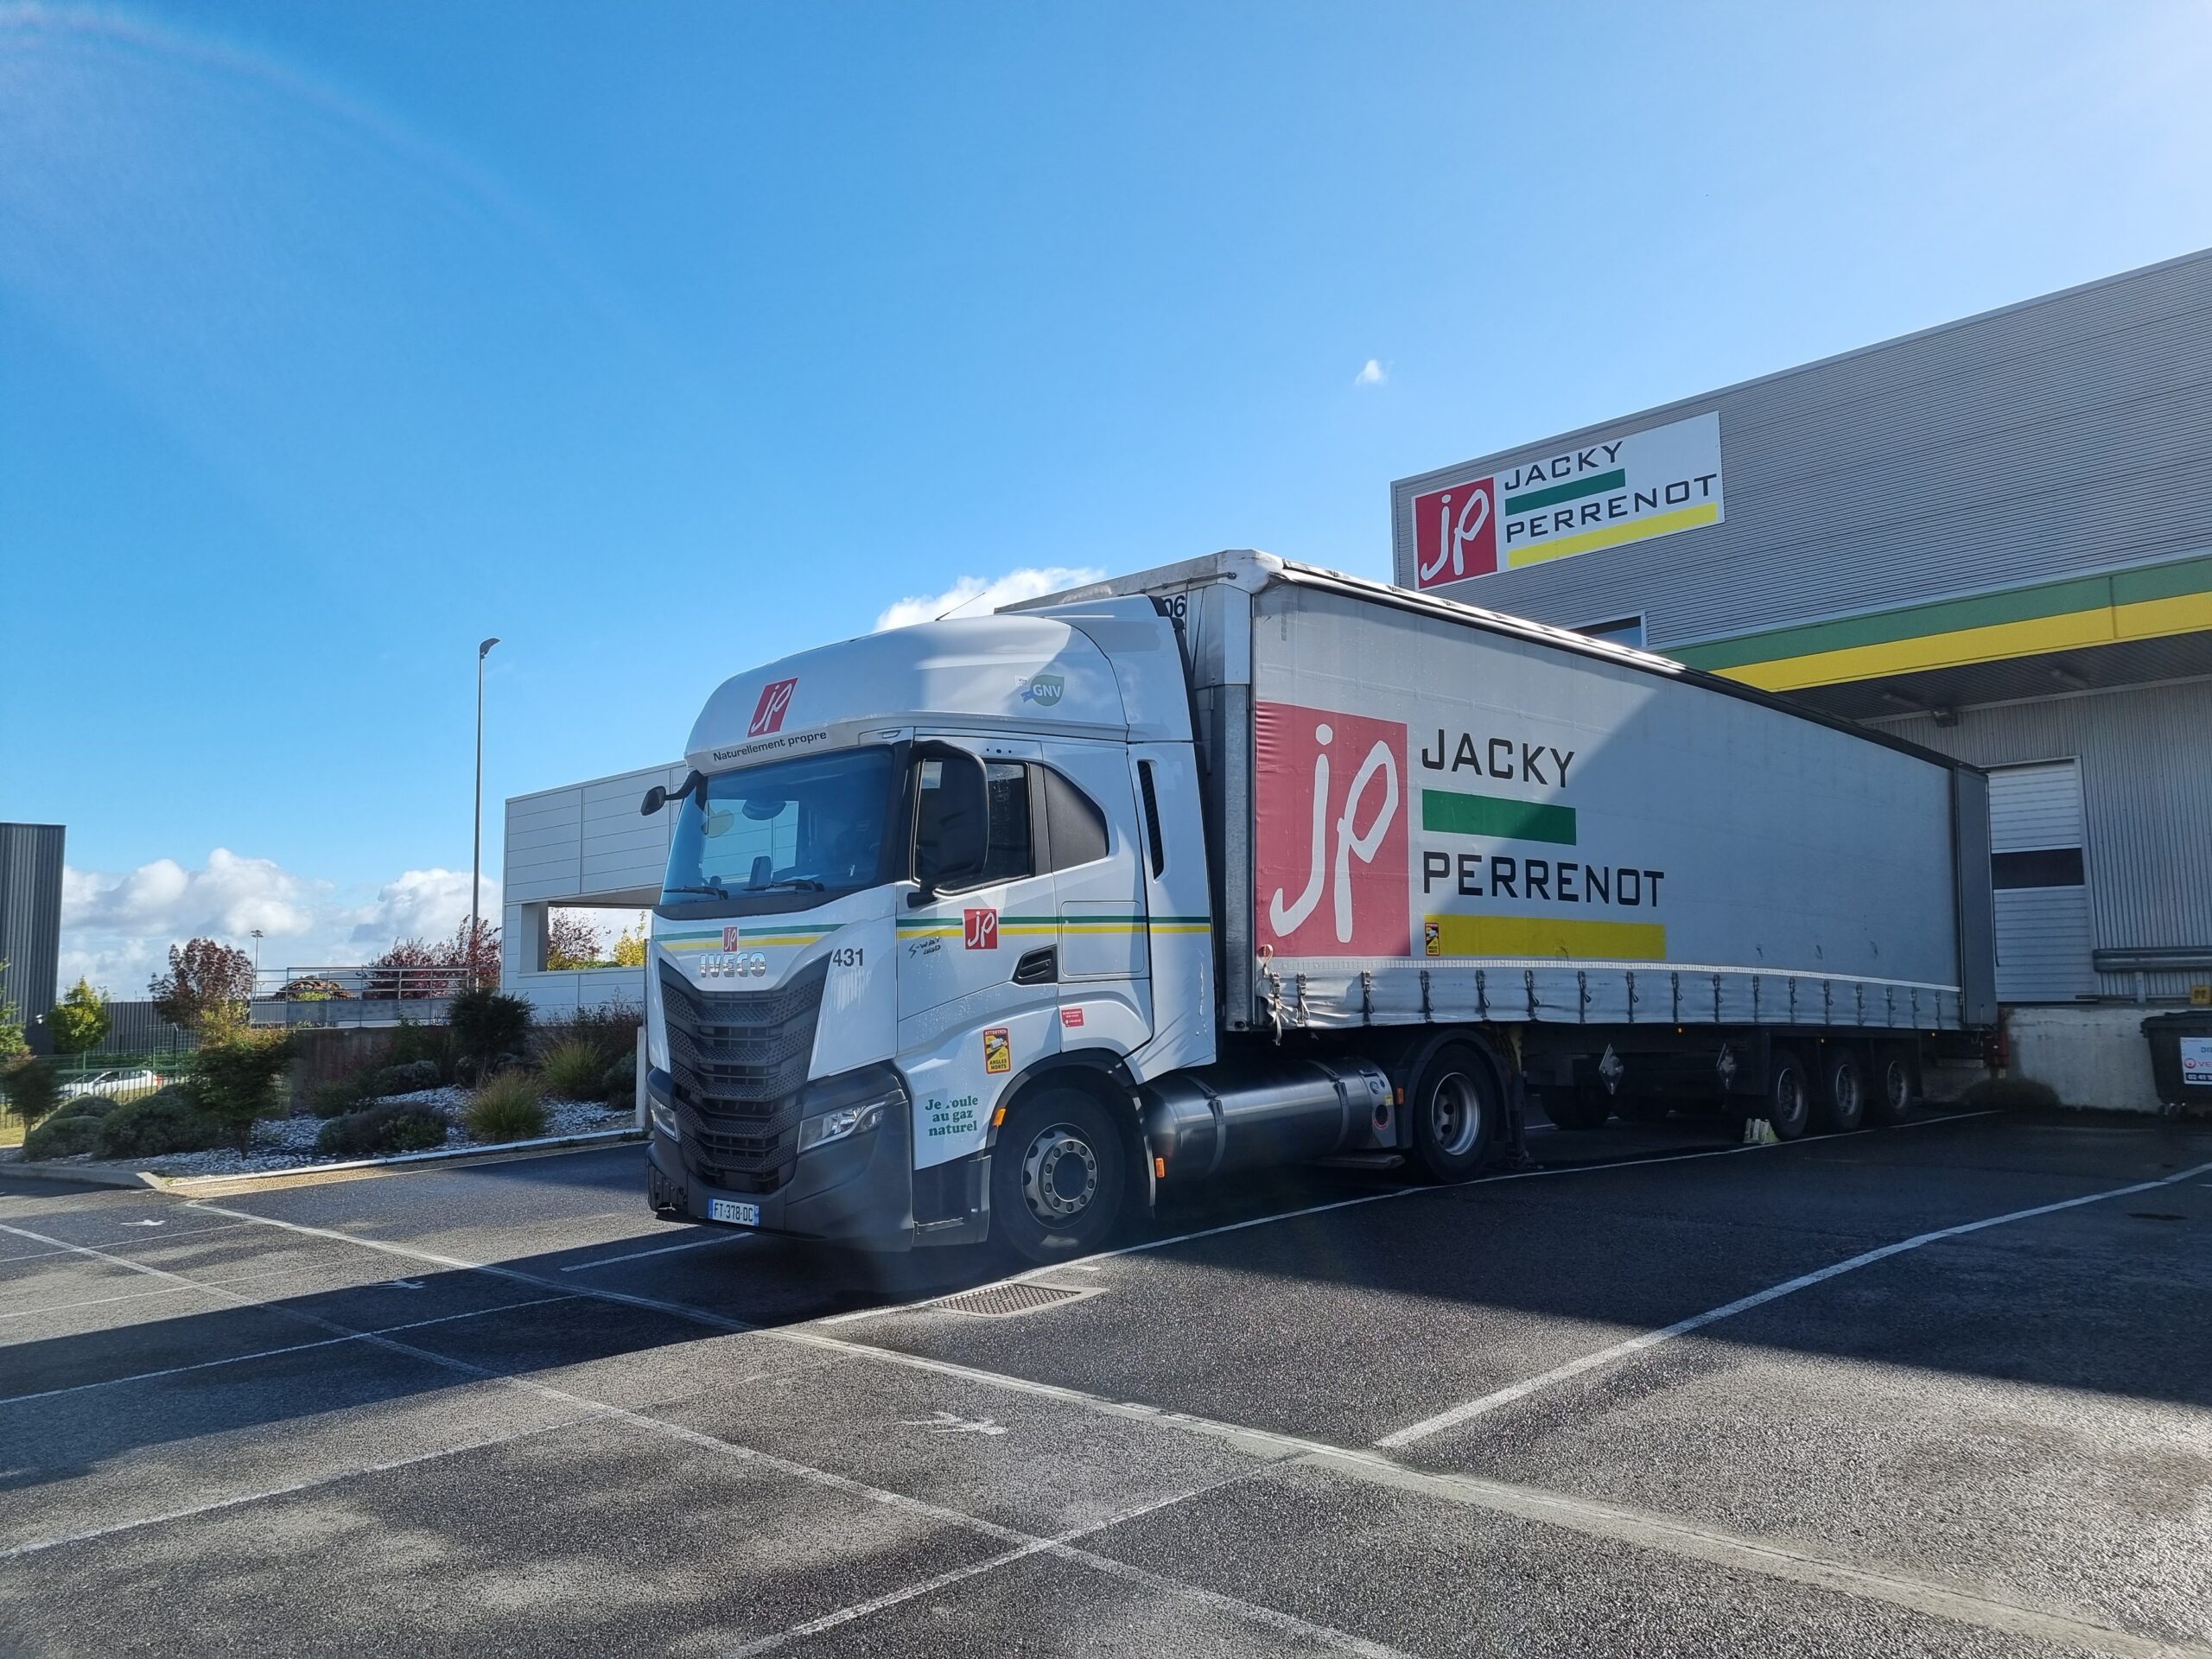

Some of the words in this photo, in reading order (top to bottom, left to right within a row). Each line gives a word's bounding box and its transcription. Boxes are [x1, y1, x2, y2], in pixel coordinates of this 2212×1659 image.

[1504, 441, 1624, 491] JACKY
[1506, 474, 1718, 543] PERRENOT
[1033, 683, 1062, 698] GNV
[713, 738, 785, 762] Naturellement
[787, 731, 827, 747] propre
[1421, 728, 1575, 789] JACKY
[1423, 851, 1665, 907] PERRENOT
[699, 951, 766, 978] IVECO
[832, 948, 863, 967] 431
[925, 1099, 942, 1110] Je
[945, 1096, 979, 1109] oule
[932, 1112, 950, 1122] au
[952, 1109, 974, 1122] gaz
[928, 1120, 977, 1136] naturel
[714, 1202, 753, 1223] FT-378-DC
